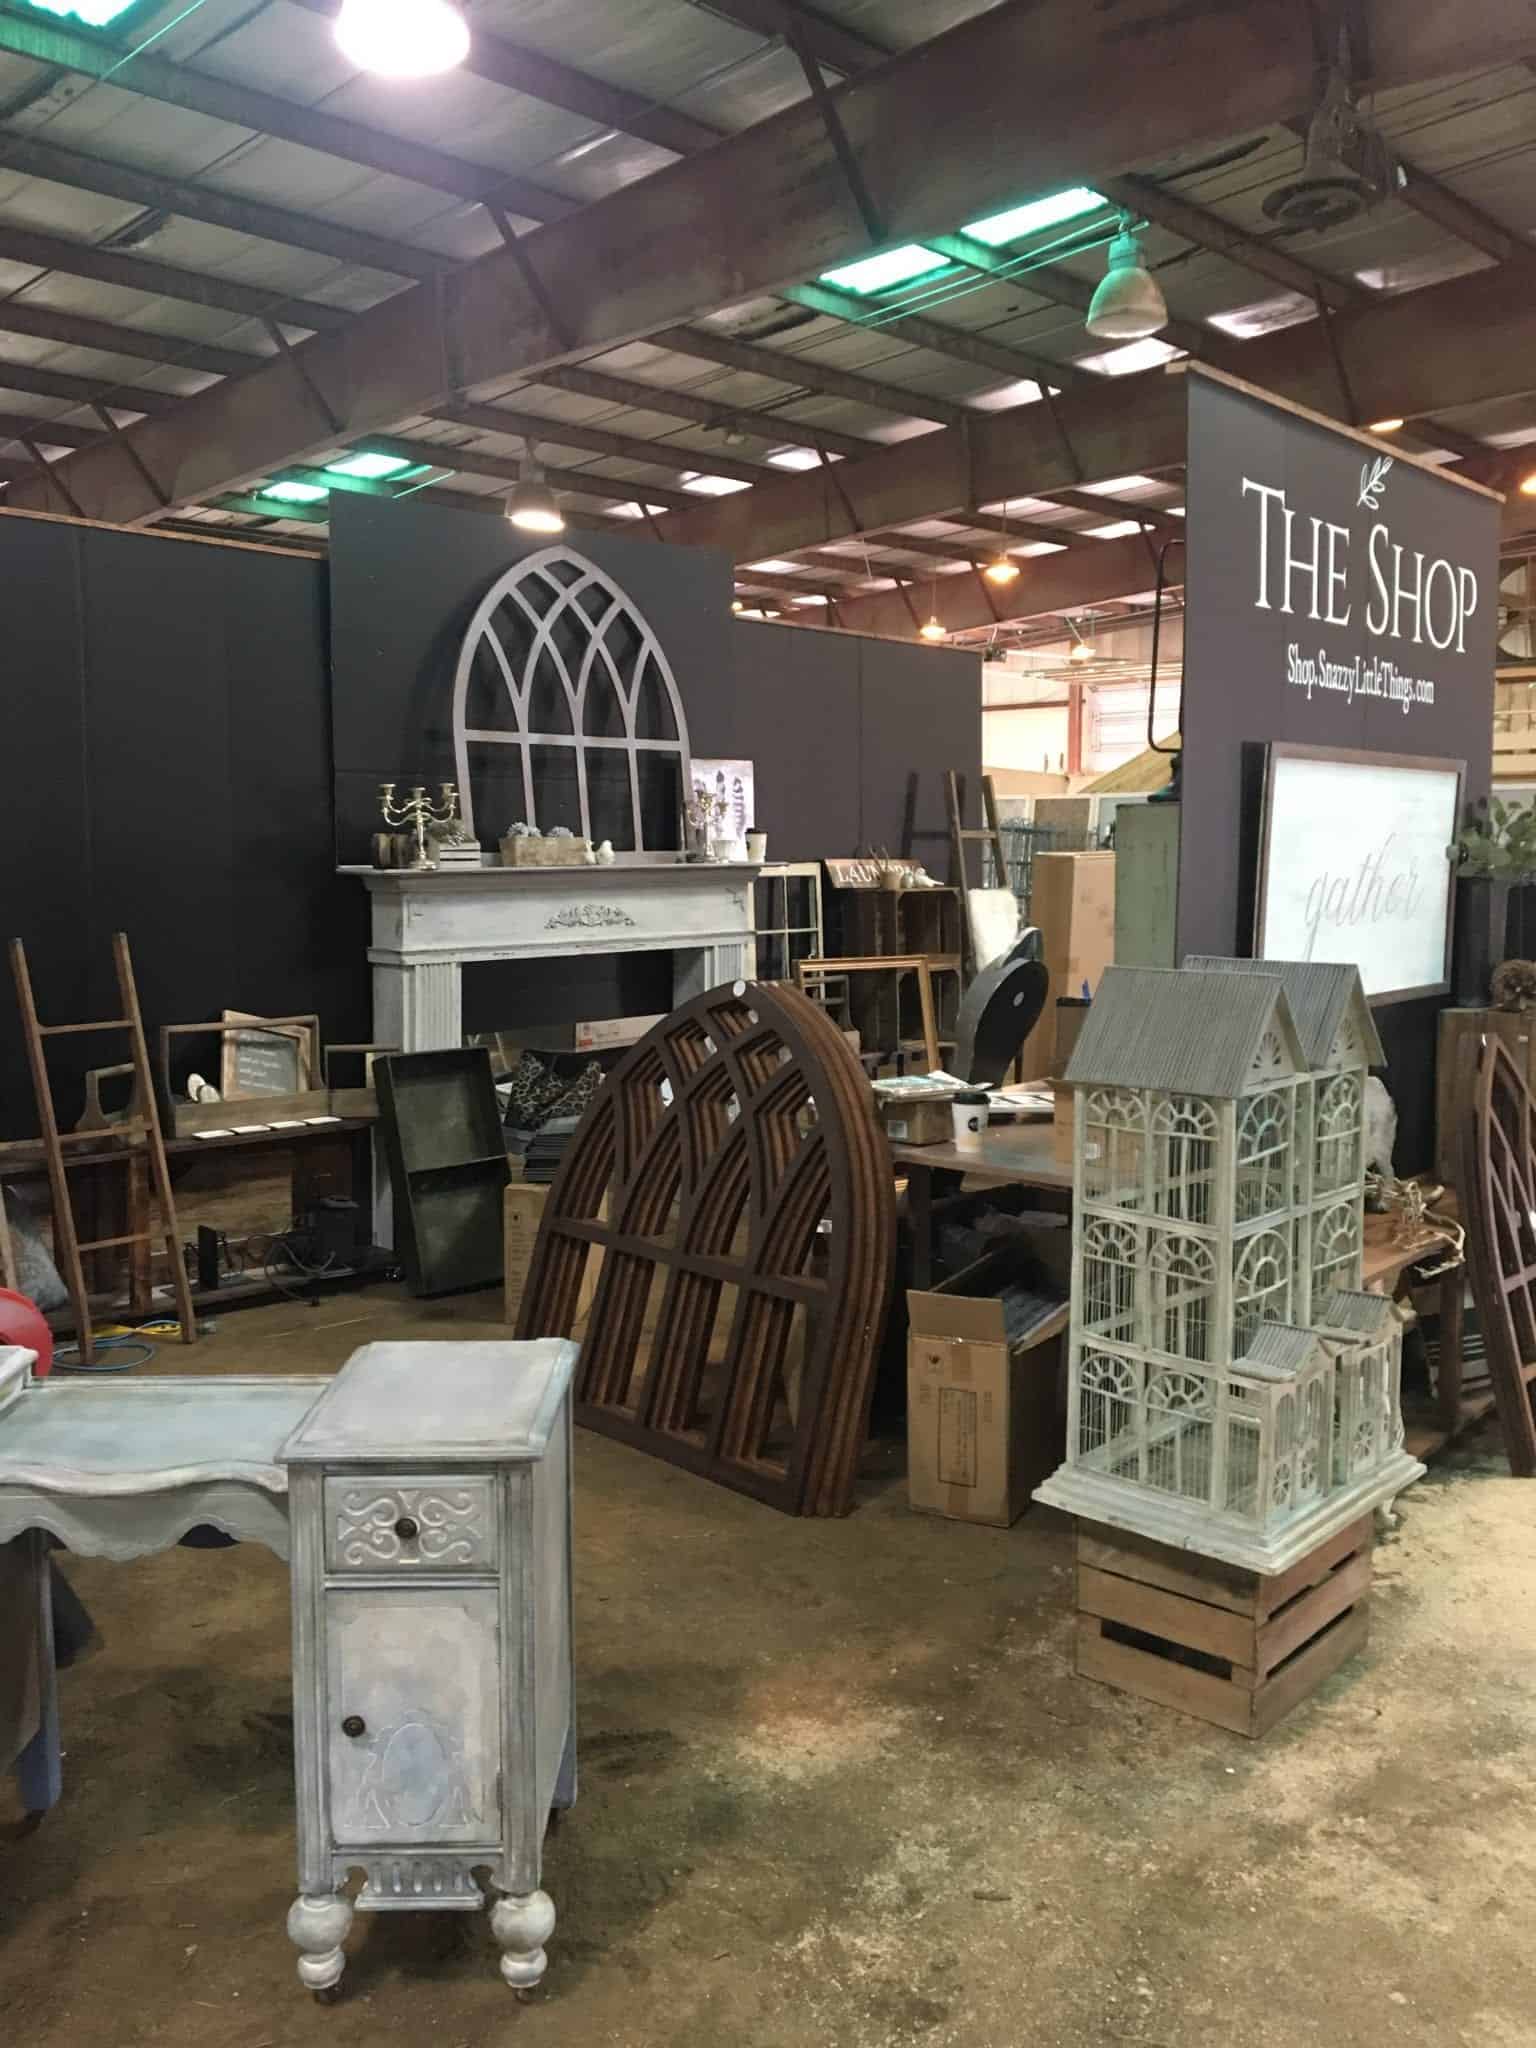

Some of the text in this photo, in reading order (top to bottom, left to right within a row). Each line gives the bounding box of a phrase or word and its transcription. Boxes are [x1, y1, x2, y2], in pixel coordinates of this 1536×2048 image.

[1242, 477, 1477, 653] THE SHOP
[1304, 832, 1424, 961] gather
